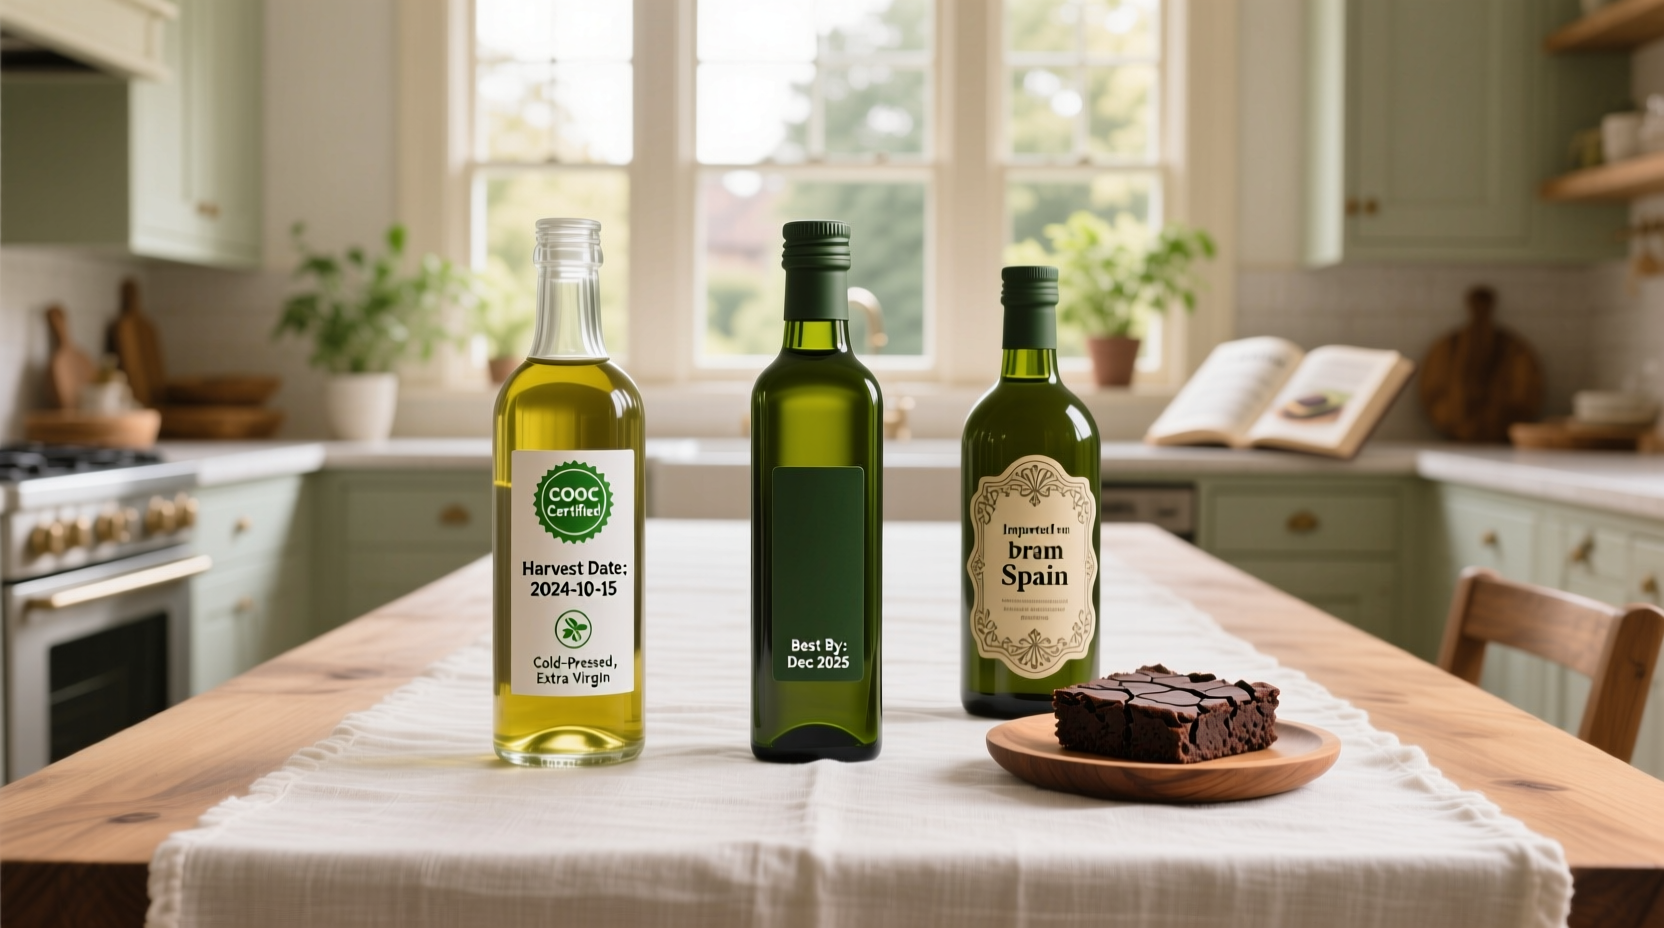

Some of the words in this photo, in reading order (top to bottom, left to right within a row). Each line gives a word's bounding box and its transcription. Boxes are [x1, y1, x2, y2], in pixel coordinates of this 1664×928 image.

[549, 487, 599, 502] COOC
[547, 503, 601, 517] Certified
[522, 560, 584, 576] Harvest
[1001, 563, 1068, 592] Spain
[530, 580, 617, 597] 2024-10-15
[791, 638, 821, 652] Best
[825, 638, 847, 655] By:
[533, 655, 617, 669] Cold-Pressed,
[787, 655, 814, 669] Dec
[817, 655, 850, 669] 2025
[536, 672, 569, 684] Extra
[572, 671, 610, 688] Virgin
